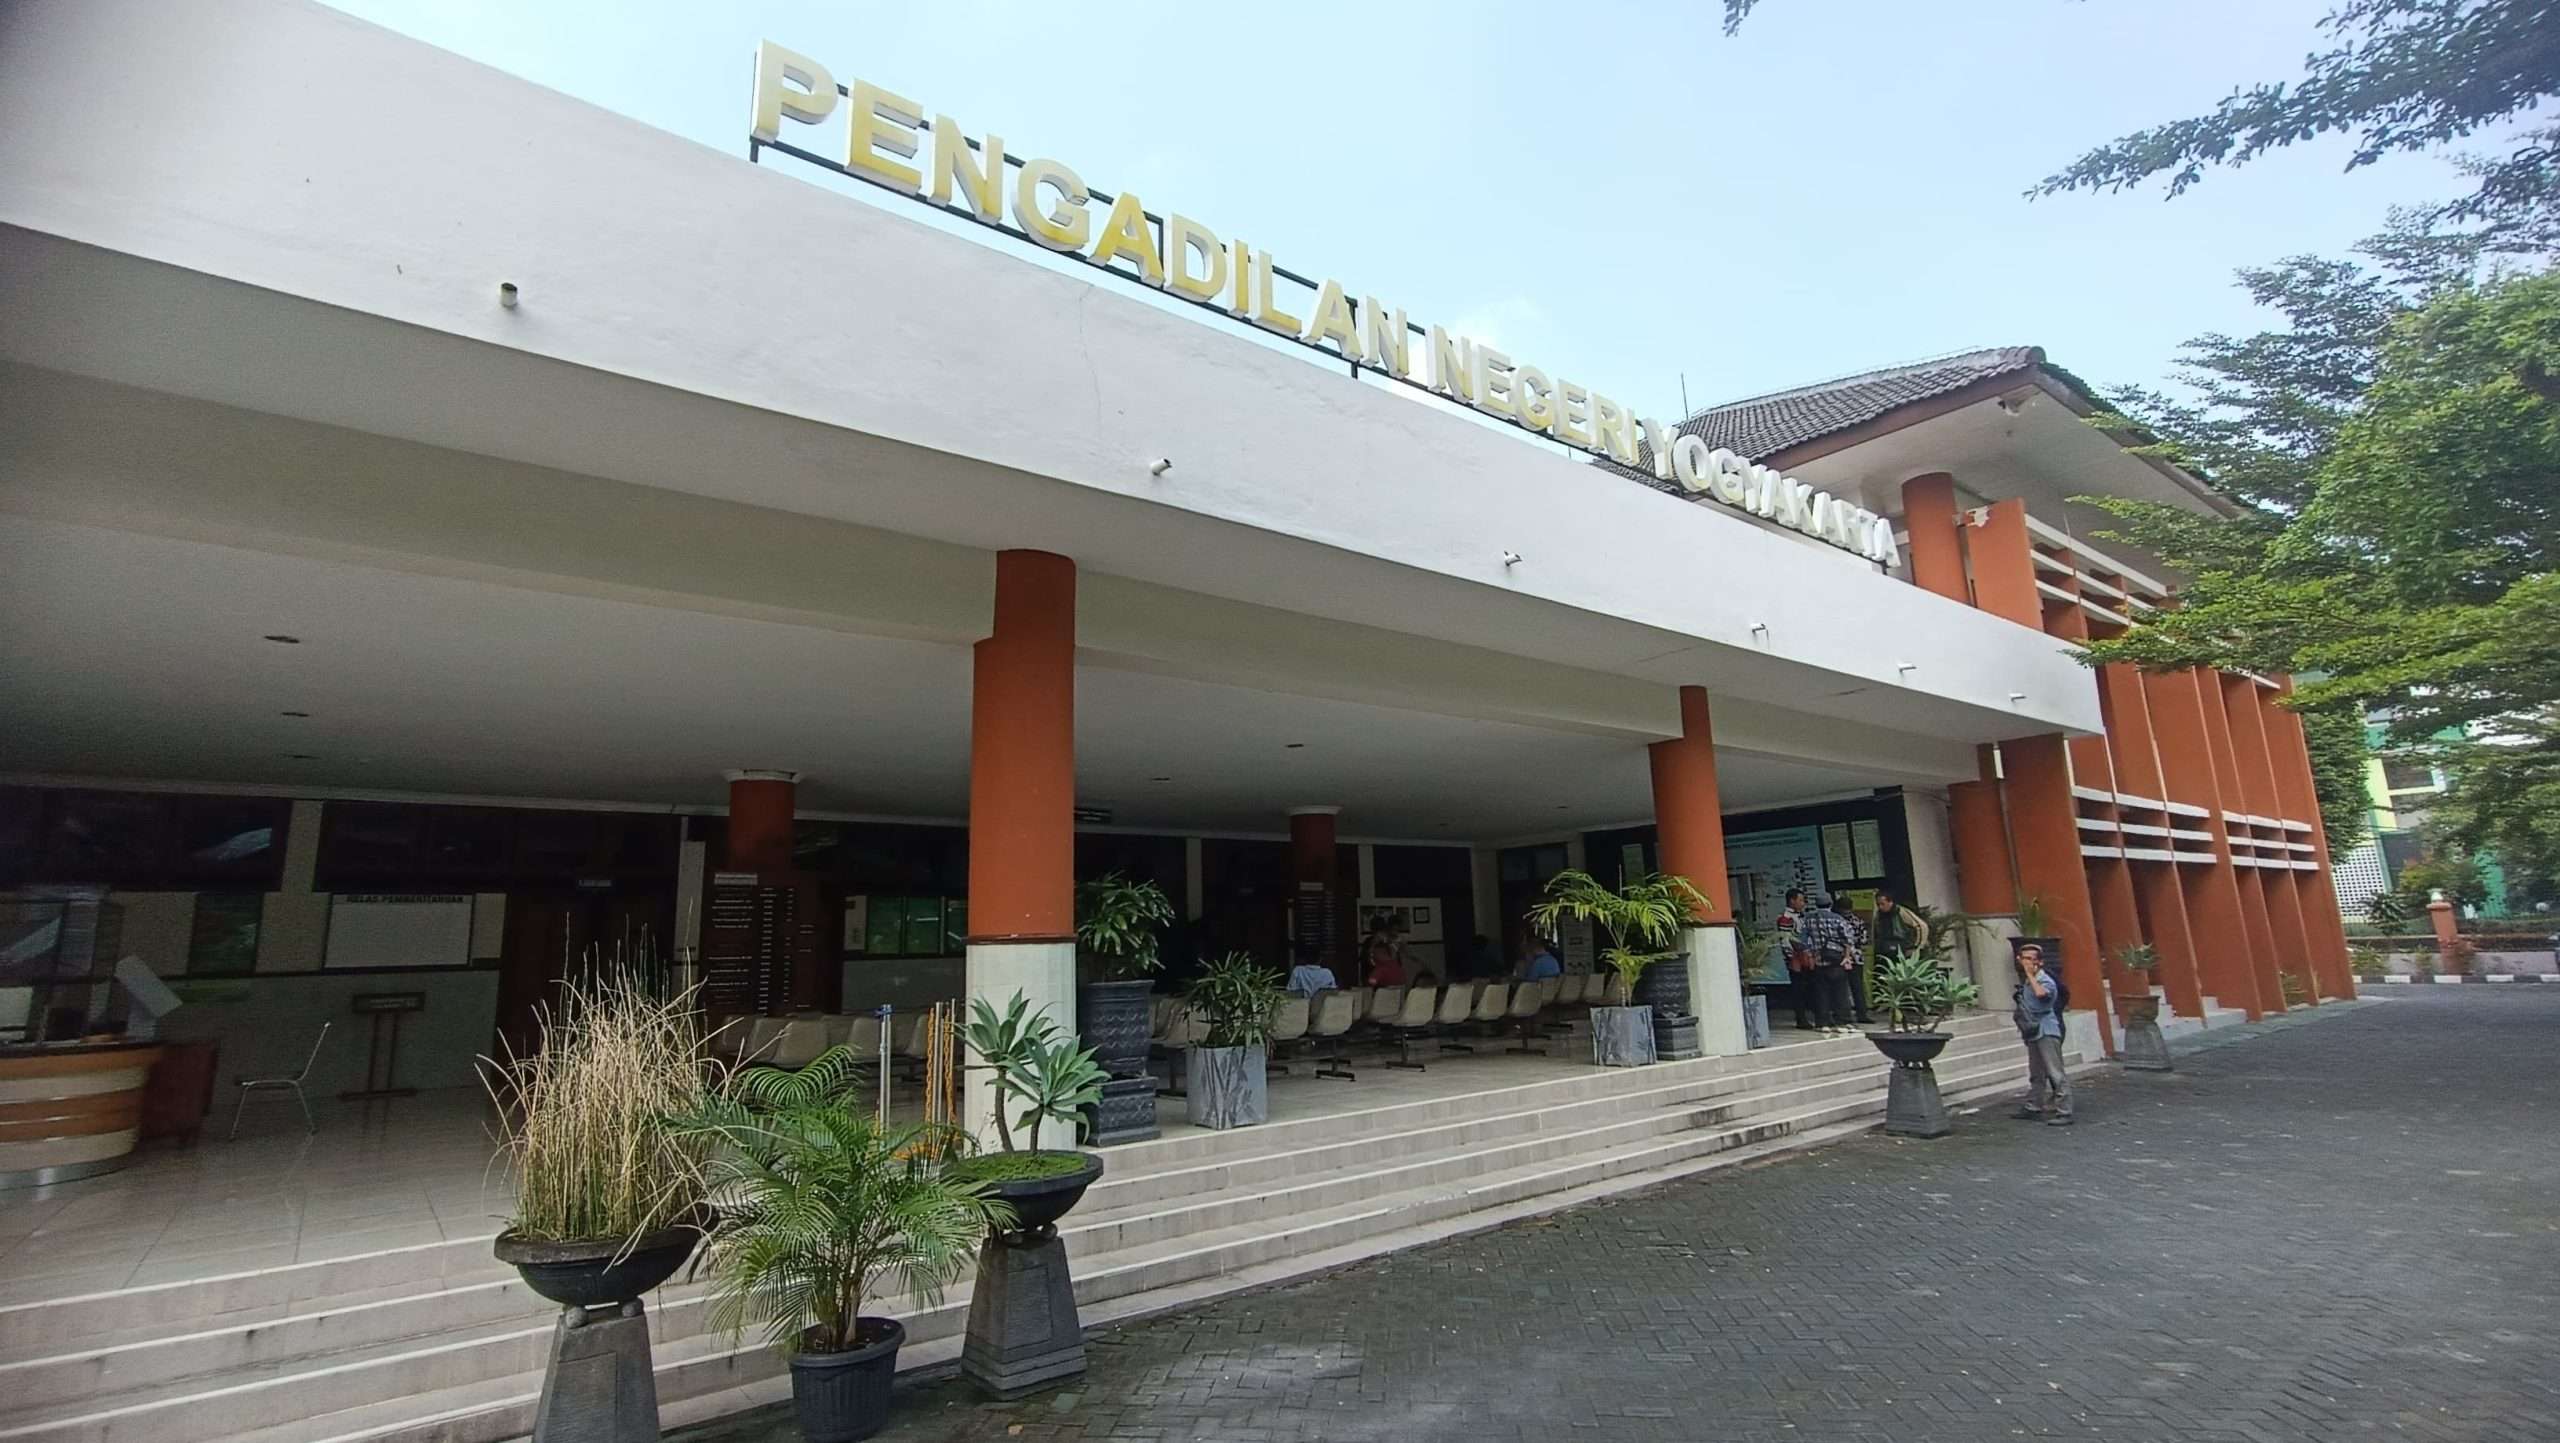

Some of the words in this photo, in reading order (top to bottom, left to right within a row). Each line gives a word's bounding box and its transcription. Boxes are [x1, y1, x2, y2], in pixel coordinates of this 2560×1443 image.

[751, 38, 1409, 379] PENGADILAN
[1425, 324, 1641, 467] NEGERI
[1640, 416, 1901, 568] YOGYAKARTA
